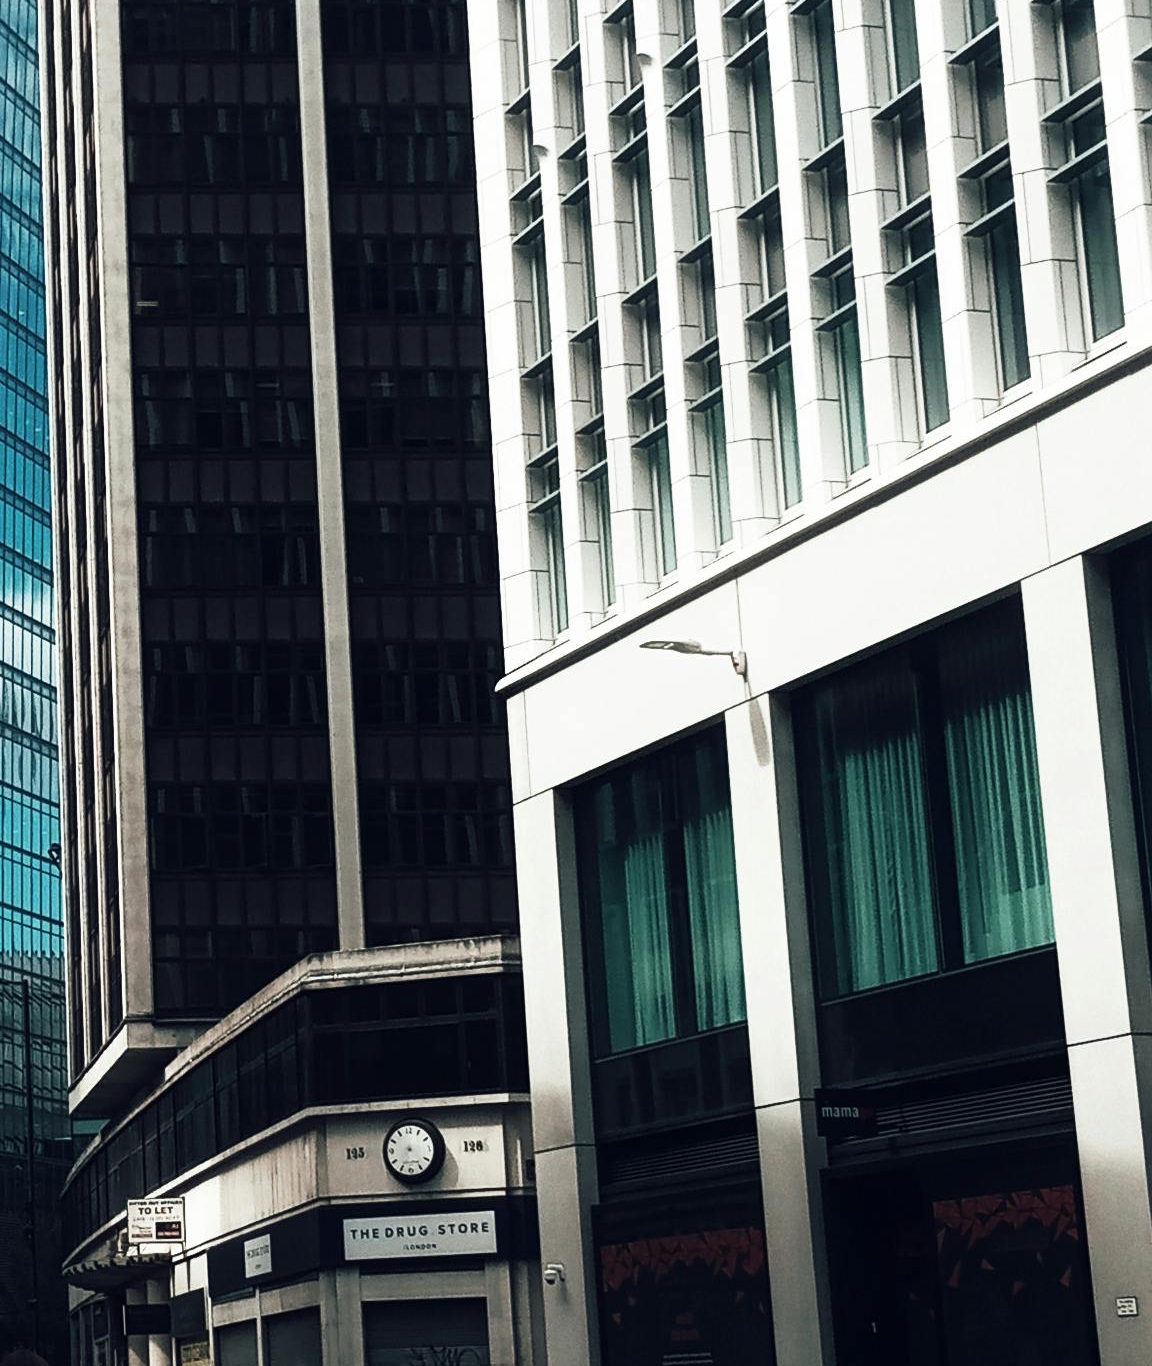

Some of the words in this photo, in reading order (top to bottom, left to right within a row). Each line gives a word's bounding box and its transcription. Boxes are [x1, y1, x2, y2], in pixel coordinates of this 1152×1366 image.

[821, 1106, 860, 1118] mama
[463, 1139, 483, 1152] 126
[346, 1147, 365, 1160] 125
[138, 1207, 152, 1215] TO
[154, 1206, 173, 1214] LET
[350, 1228, 380, 1240] THE
[385, 1225, 428, 1238] DRUG
[438, 1222, 489, 1235] STORE
